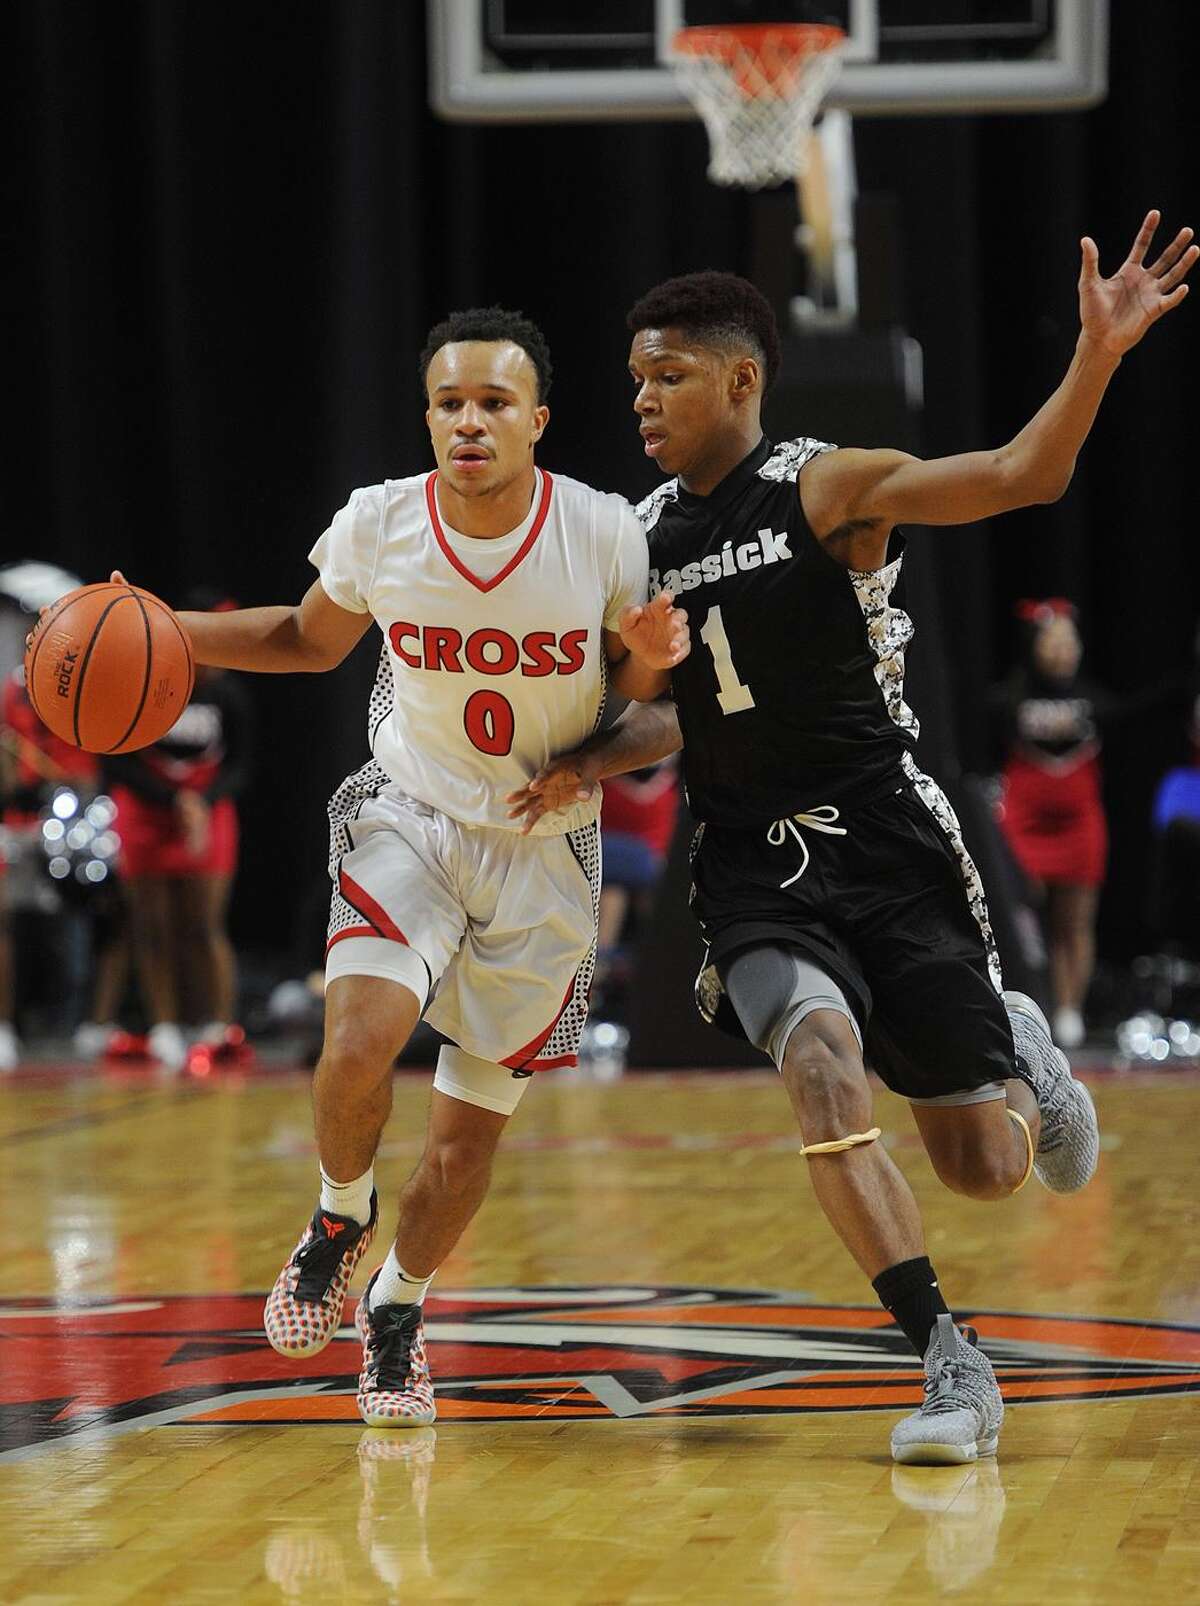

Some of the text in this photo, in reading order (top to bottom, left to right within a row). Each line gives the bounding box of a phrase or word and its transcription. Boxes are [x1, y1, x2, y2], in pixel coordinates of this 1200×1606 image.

[58, 651, 79, 698] ROCK
[388, 621, 589, 678] CROSS
[699, 604, 756, 715] 1
[463, 689, 515, 757] 0
